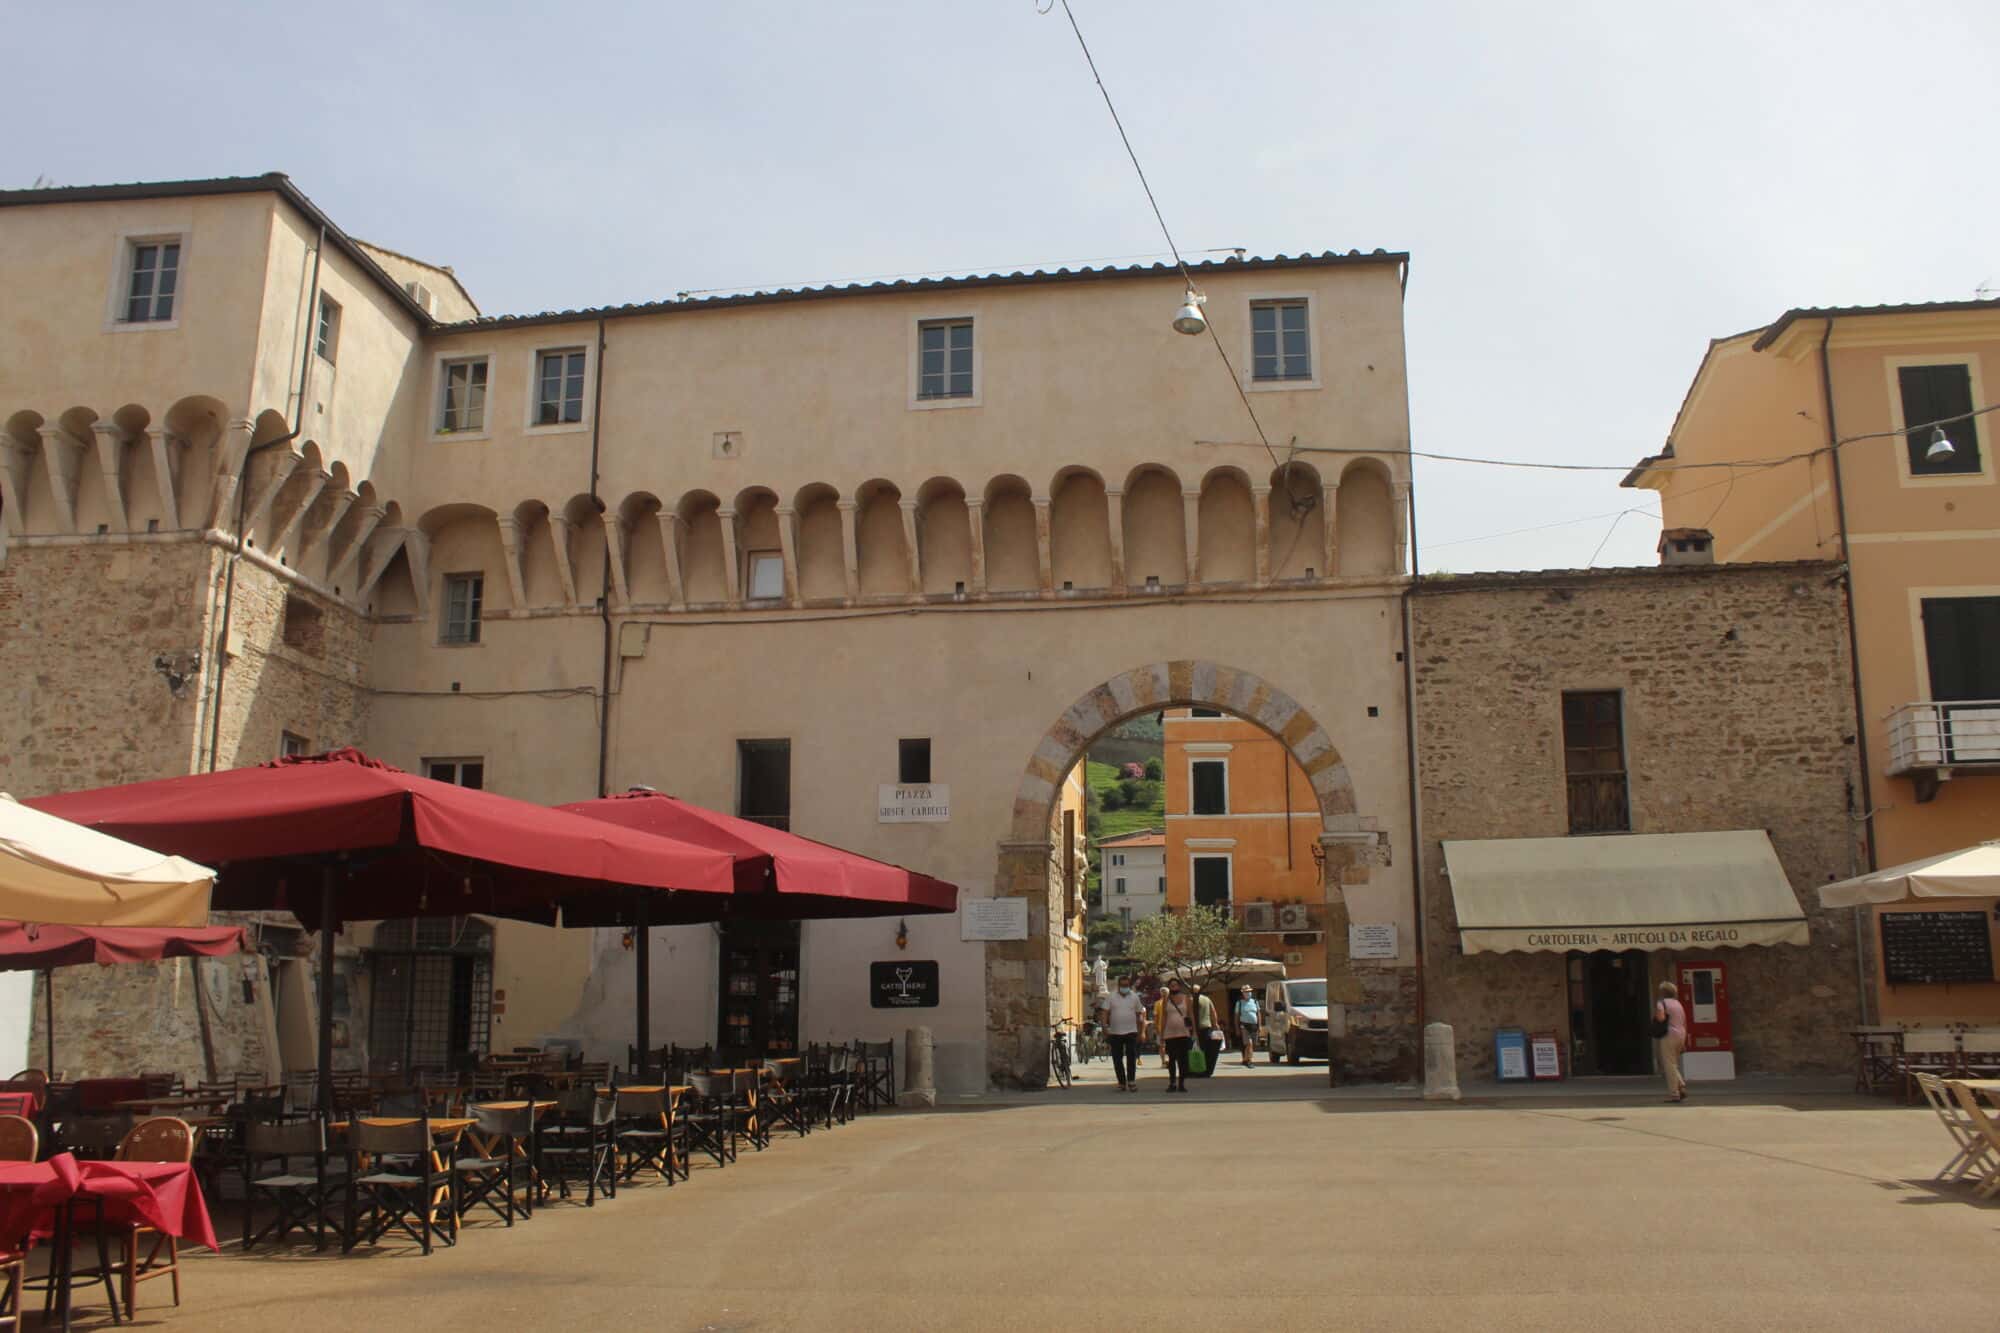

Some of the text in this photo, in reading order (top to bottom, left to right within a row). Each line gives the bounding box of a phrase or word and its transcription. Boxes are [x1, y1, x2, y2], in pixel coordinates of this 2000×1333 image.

[895, 790, 932, 800] PIAZZA
[1527, 933, 1598, 946] CARTOLERIA
[1612, 932, 1664, 944] ARTICOLI
[1669, 931, 1687, 943] DA
[1690, 929, 1739, 942] REGALO
